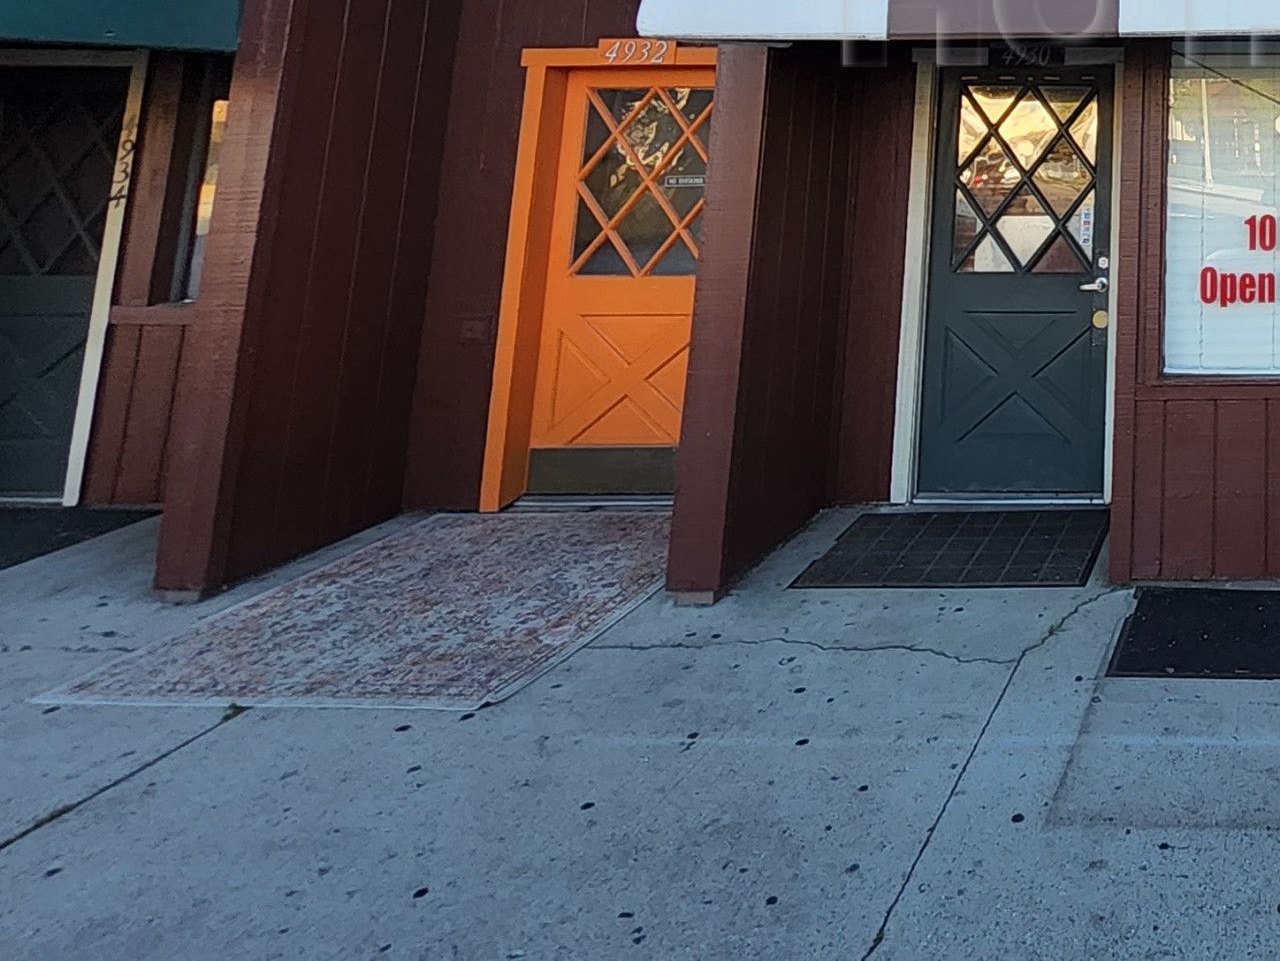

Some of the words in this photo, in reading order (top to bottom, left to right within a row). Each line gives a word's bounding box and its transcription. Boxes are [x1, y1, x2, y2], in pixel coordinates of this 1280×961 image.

[605, 41, 668, 64] 4932
[1001, 45, 1050, 67] 4930
[1244, 215, 1276, 251] 10
[1200, 266, 1275, 307] Open
